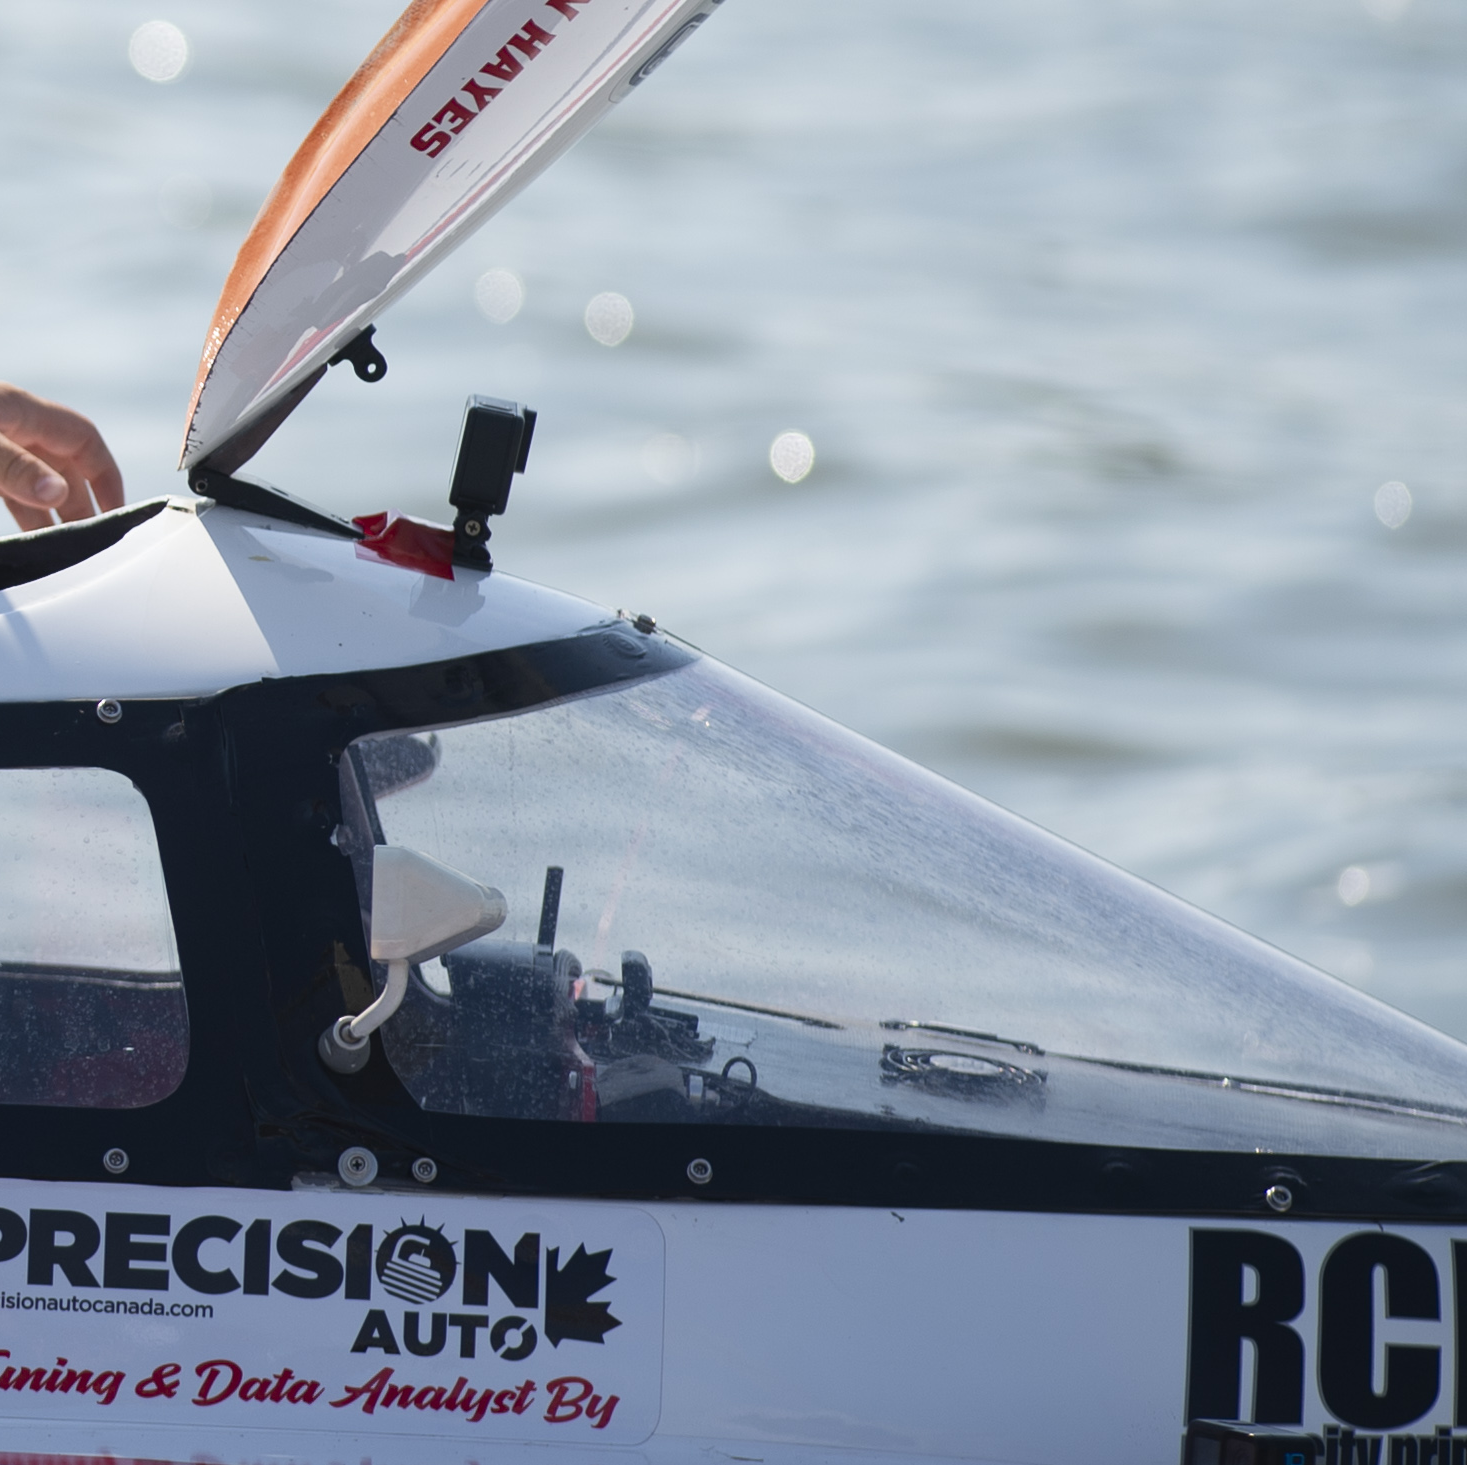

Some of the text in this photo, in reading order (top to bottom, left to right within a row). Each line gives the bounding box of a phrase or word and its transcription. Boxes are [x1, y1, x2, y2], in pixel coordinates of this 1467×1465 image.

[408, 18, 557, 159] HAYES
[350, 1309, 539, 1362] AUTO
[1183, 1226, 1467, 1431] RC
[134, 1362, 182, 1399] &
[191, 1358, 326, 1407] Data
[328, 1366, 538, 1423] Analyst
[543, 1375, 621, 1430] By
